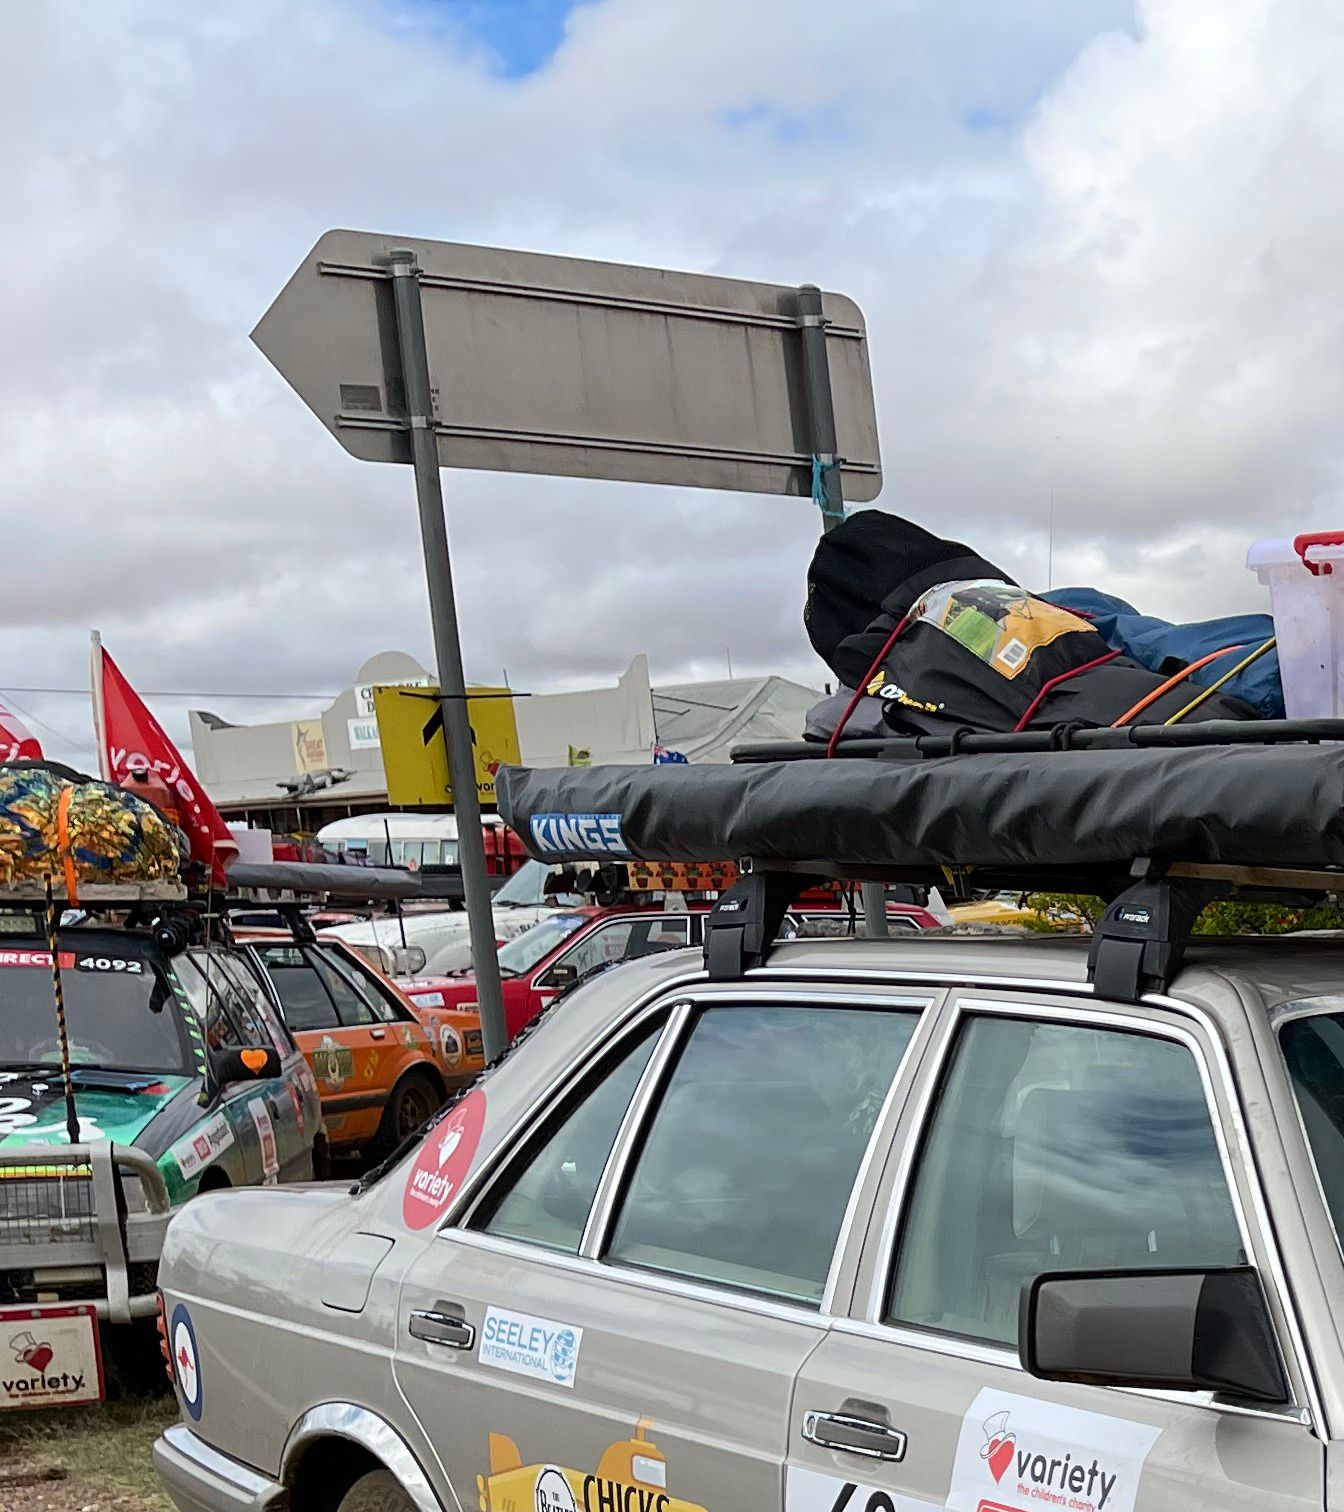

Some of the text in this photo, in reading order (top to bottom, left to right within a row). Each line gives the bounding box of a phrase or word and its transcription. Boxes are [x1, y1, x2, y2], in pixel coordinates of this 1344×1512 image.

[531, 814, 628, 852] KINGS
[79, 957, 142, 974] 4092
[413, 1168, 454, 1206] variety
[484, 1316, 554, 1355] SEELEY
[482, 1343, 548, 1372] INTERNATIONAL
[2, 1372, 85, 1393] variety
[1016, 1482, 1030, 1497] the
[1031, 1485, 1067, 1506] children's
[1017, 1450, 1117, 1511] variety
[551, 1491, 560, 1502] THE
